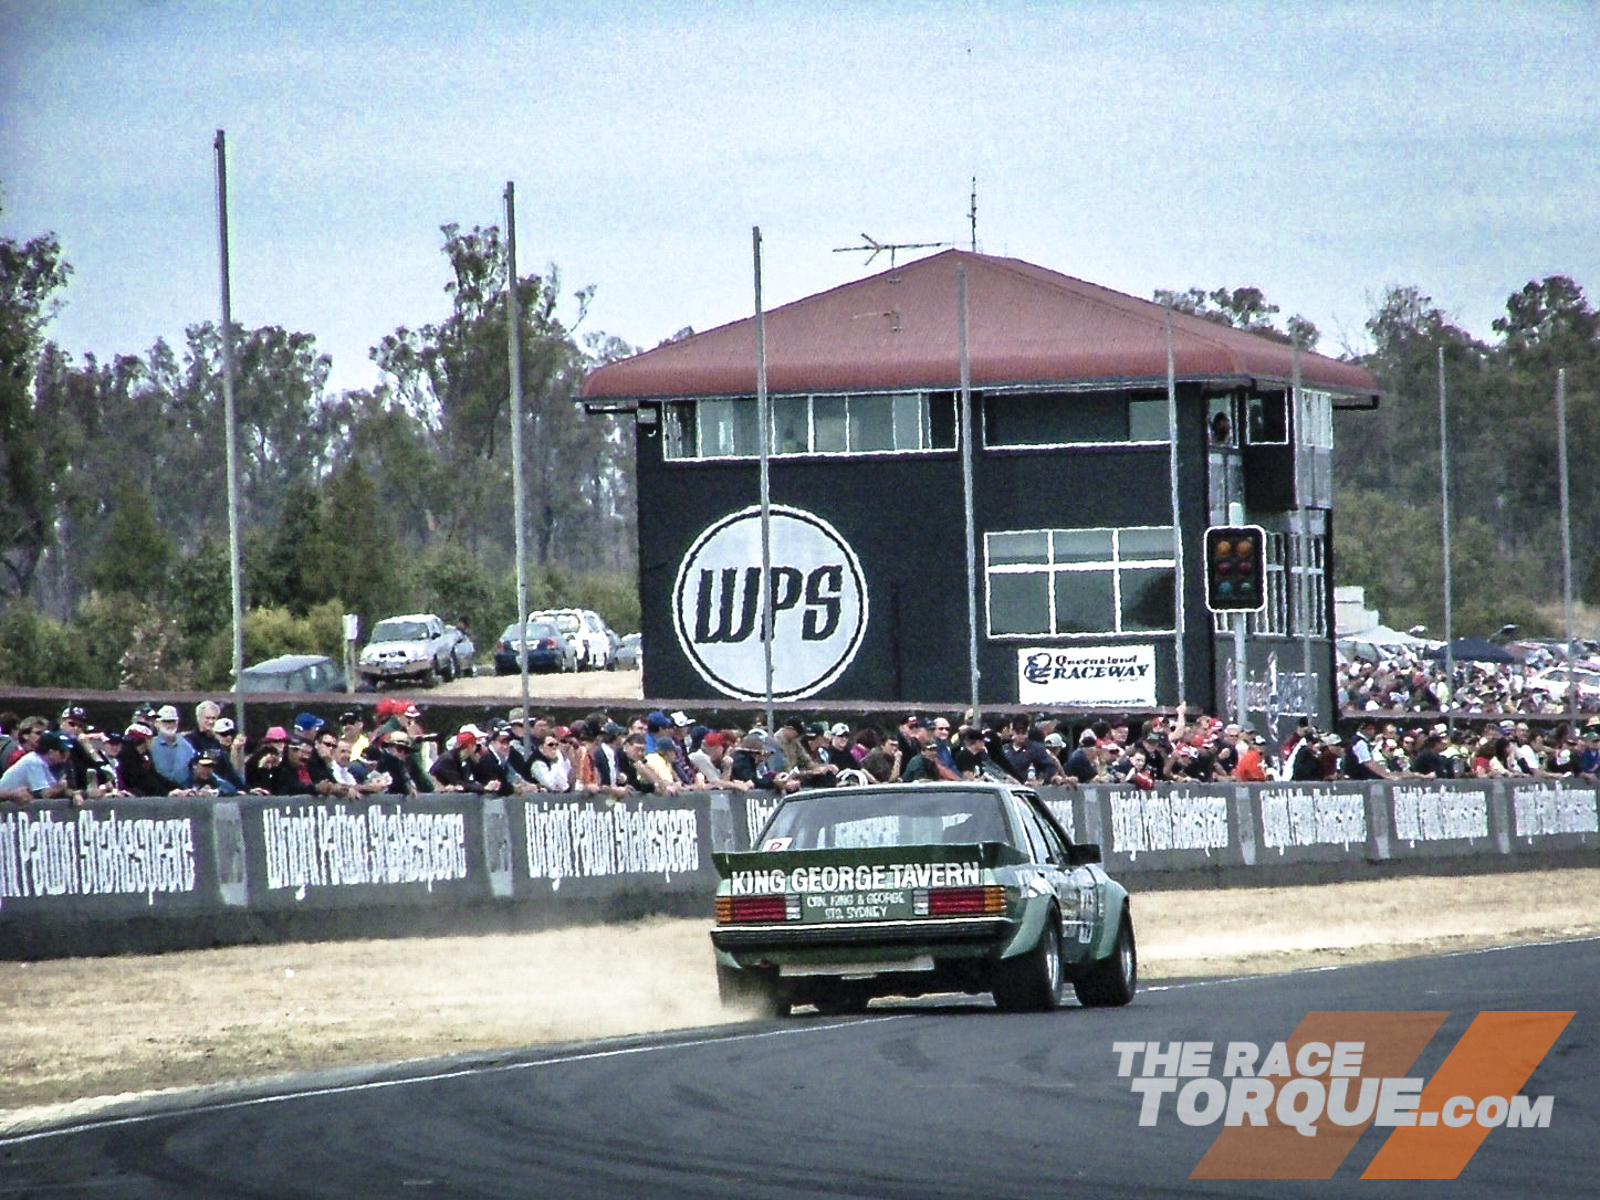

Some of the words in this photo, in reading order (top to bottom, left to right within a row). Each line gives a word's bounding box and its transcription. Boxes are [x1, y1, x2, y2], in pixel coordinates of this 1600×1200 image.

[694, 565, 844, 644] WPS
[1053, 663, 1150, 680] RACEWAY
[732, 869, 786, 895] KING
[792, 865, 887, 893] GEORGE
[889, 861, 980, 889] TAVERN
[857, 894, 865, 905] &
[846, 905, 888, 919] SYDNEY
